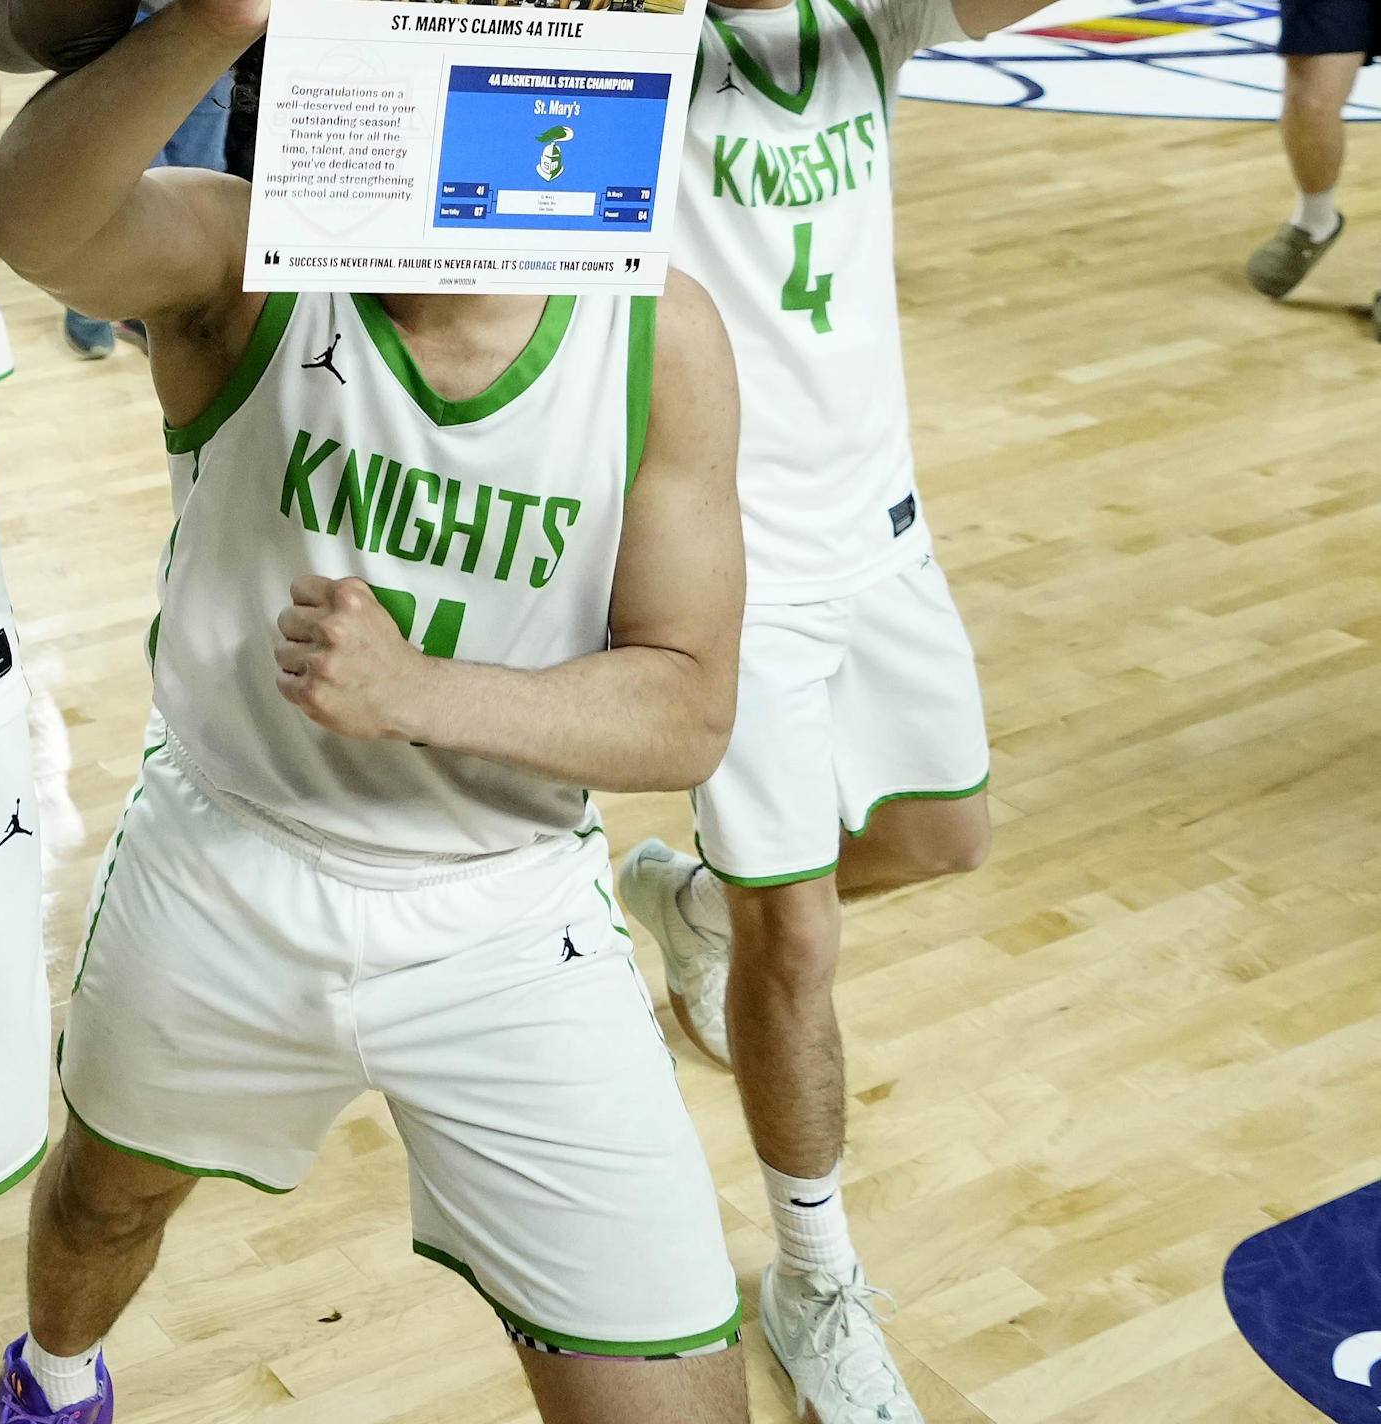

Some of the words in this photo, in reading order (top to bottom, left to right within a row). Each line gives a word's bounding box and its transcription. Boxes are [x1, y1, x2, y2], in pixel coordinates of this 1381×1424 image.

[391, 14, 411, 31] ST.
[415, 15, 468, 33] MARY'S
[471, 18, 523, 36] CLAIMS
[525, 20, 542, 36] 4A
[547, 21, 584, 38] TITLE
[487, 73, 501, 86] 4A
[500, 73, 557, 88] BASKETBALL
[557, 75, 586, 89] STATE
[585, 77, 634, 91] CHAMPION
[291, 84, 378, 98] Congratulations
[381, 90, 394, 98] on
[276, 99, 352, 111] well-deserved
[354, 101, 375, 112] end
[378, 103, 389, 112] to
[391, 105, 416, 115] your
[533, 99, 547, 114] St.
[547, 99, 581, 118] Mary's
[291, 115, 357, 128] outstanding
[359, 116, 400, 127] season!
[289, 128, 322, 139] Thank
[326, 132, 345, 142] you
[348, 130, 363, 141] for
[366, 130, 380, 141] all
[383, 131, 400, 141] the
[281, 143, 308, 155] time,
[311, 143, 345, 156] talent,
[348, 145, 368, 155] and
[371, 147, 408, 159] energy
[291, 157, 326, 170] you've
[328, 158, 381, 170] dedicated
[384, 161, 395, 170] to
[713, 112, 875, 208] KNIGHTS
[266, 172, 314, 185] inspiring
[316, 173, 337, 184] and
[339, 174, 414, 188] strengthening
[264, 189, 288, 199] your
[291, 187, 326, 198] school
[328, 188, 349, 198] and
[351, 189, 412, 201] community.
[288, 256, 328, 267] SUCCESS
[329, 257, 338, 267] IS
[340, 257, 368, 267] NEVER
[369, 257, 395, 268] FINAL.
[397, 258, 432, 268] FAILURE
[433, 258, 442, 269] IS
[443, 258, 471, 269] NEVER
[472, 259, 497, 269] FATAL.
[501, 259, 517, 270] IT'S
[518, 260, 556, 270] COURAGE
[559, 260, 580, 271] THAT
[581, 261, 614, 271] COUNTS
[780, 222, 833, 334] 4
[279, 429, 581, 588] KNIGHTS
